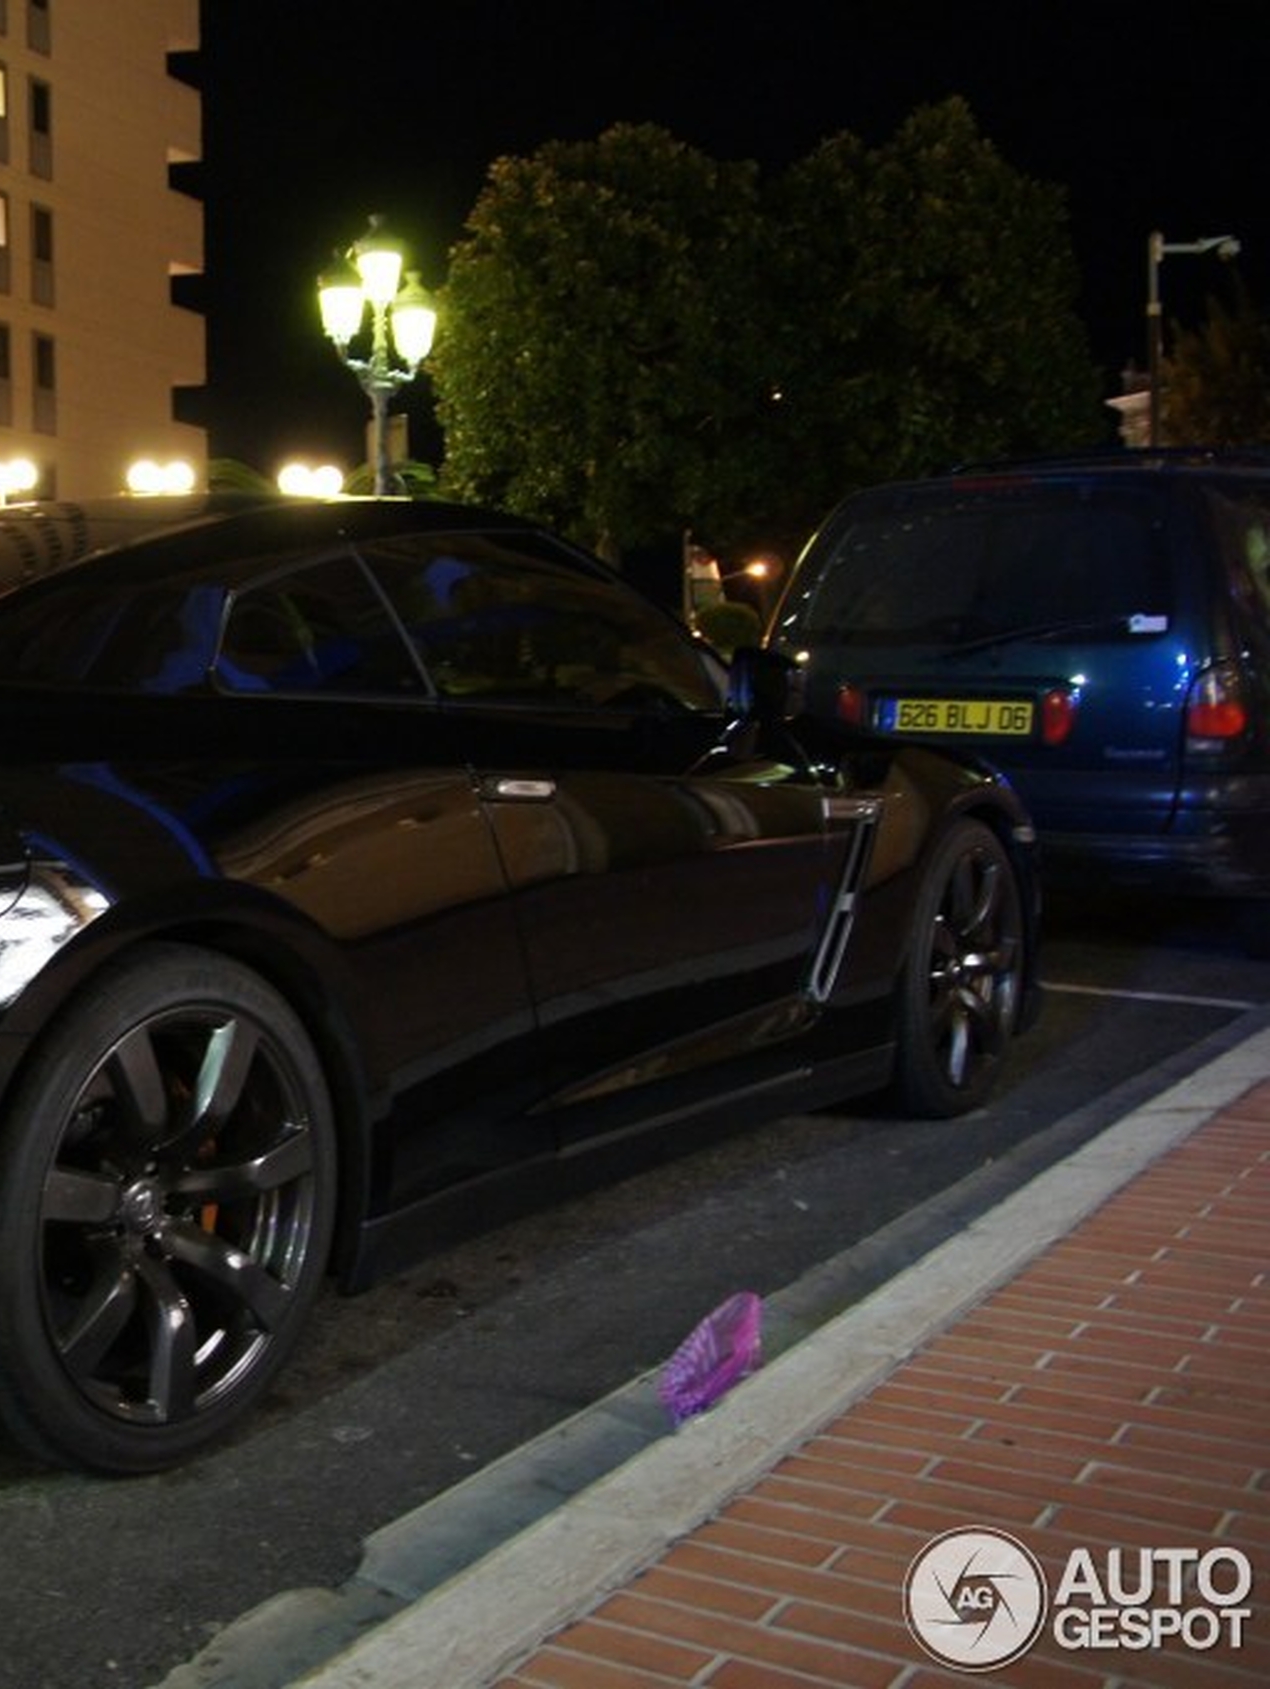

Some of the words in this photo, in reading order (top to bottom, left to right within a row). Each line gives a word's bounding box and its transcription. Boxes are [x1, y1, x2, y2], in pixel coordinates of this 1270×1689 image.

[898, 703, 938, 728] 626
[946, 704, 991, 730] BLJ
[998, 706, 1028, 731] 06
